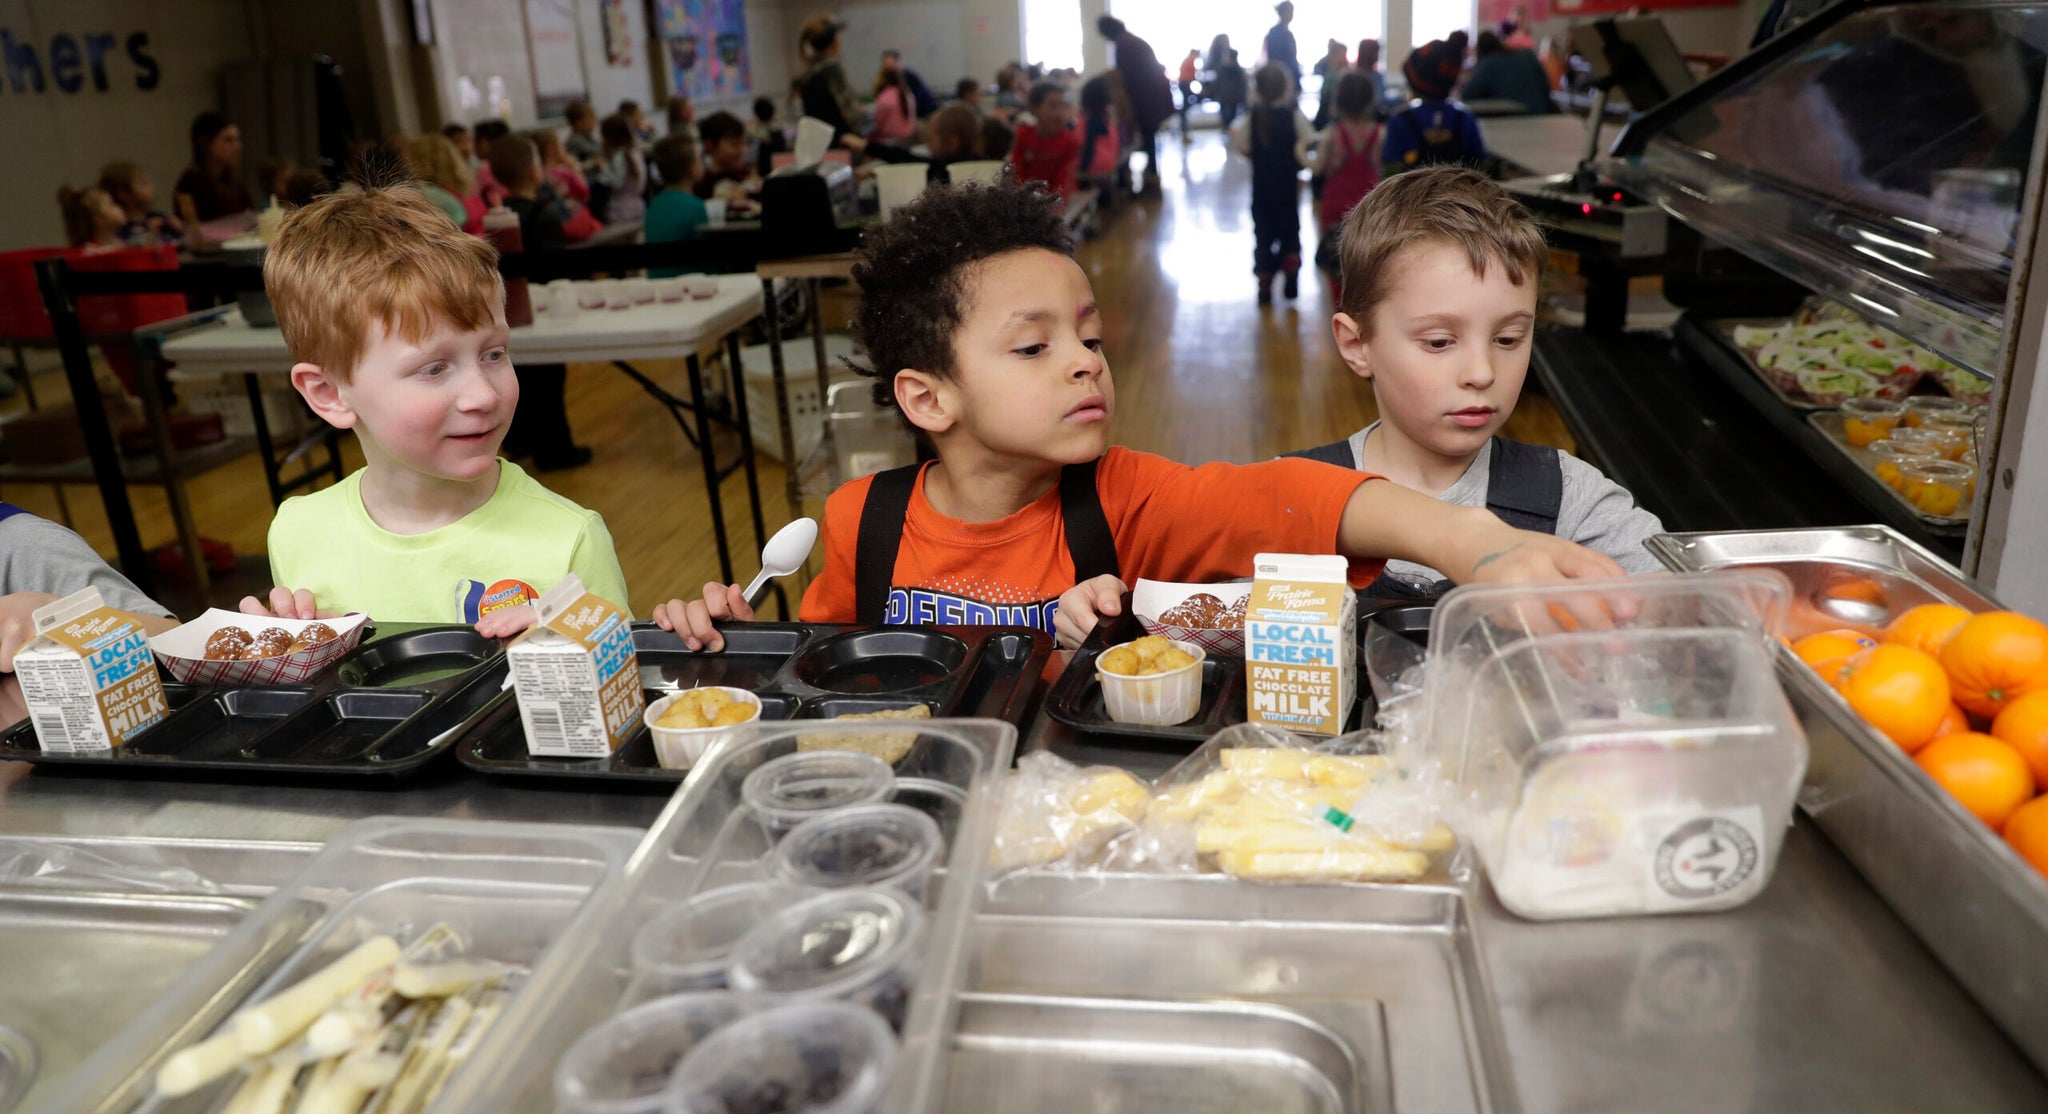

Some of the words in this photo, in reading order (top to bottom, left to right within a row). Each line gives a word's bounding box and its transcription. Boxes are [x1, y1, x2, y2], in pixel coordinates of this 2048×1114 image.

[0, 28, 160, 93] hers
[489, 584, 521, 603] Started
[1267, 587, 1314, 602] Prairie
[1285, 597, 1326, 609] Farms
[593, 624, 630, 666] LOCAL
[1252, 623, 1333, 644] LOCAL
[90, 633, 146, 670] LOCAL
[598, 639, 635, 686] FRESH
[1253, 643, 1334, 665] FRESH
[96, 648, 152, 690] FRESH
[602, 681, 617, 703] FAT
[617, 661, 637, 689] FREE
[1253, 667, 1283, 681] FAT
[1288, 669, 1331, 684] FREE
[103, 687, 124, 707] FAT
[127, 670, 156, 694] FREE
[107, 683, 160, 717] CHOCOLATE
[1254, 680, 1331, 695] CHOCOLATE
[1254, 691, 1331, 717] MILK
[109, 692, 165, 737] MILK
[607, 684, 643, 735] MILK
[1262, 712, 1300, 724] VITAMIN
